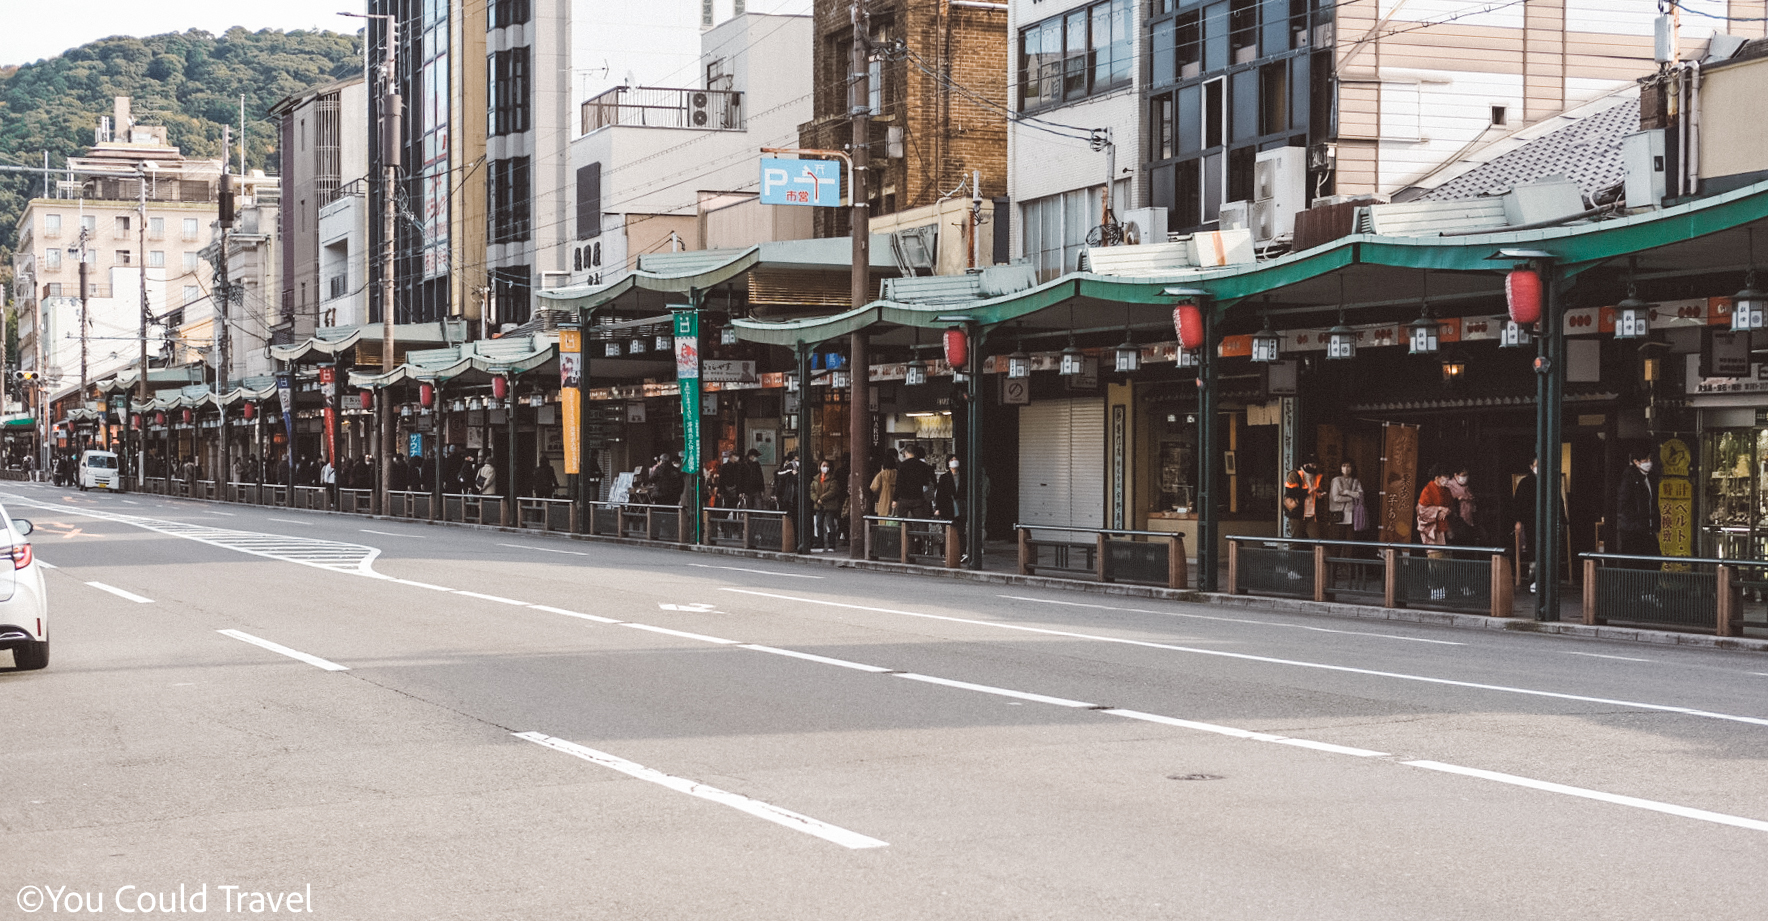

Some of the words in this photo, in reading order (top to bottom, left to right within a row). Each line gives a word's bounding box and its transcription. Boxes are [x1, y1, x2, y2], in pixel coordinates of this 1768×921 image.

[765, 168, 788, 196] P
[786, 190, 809, 203] 市営
[410, 434, 418, 457] サウナ
